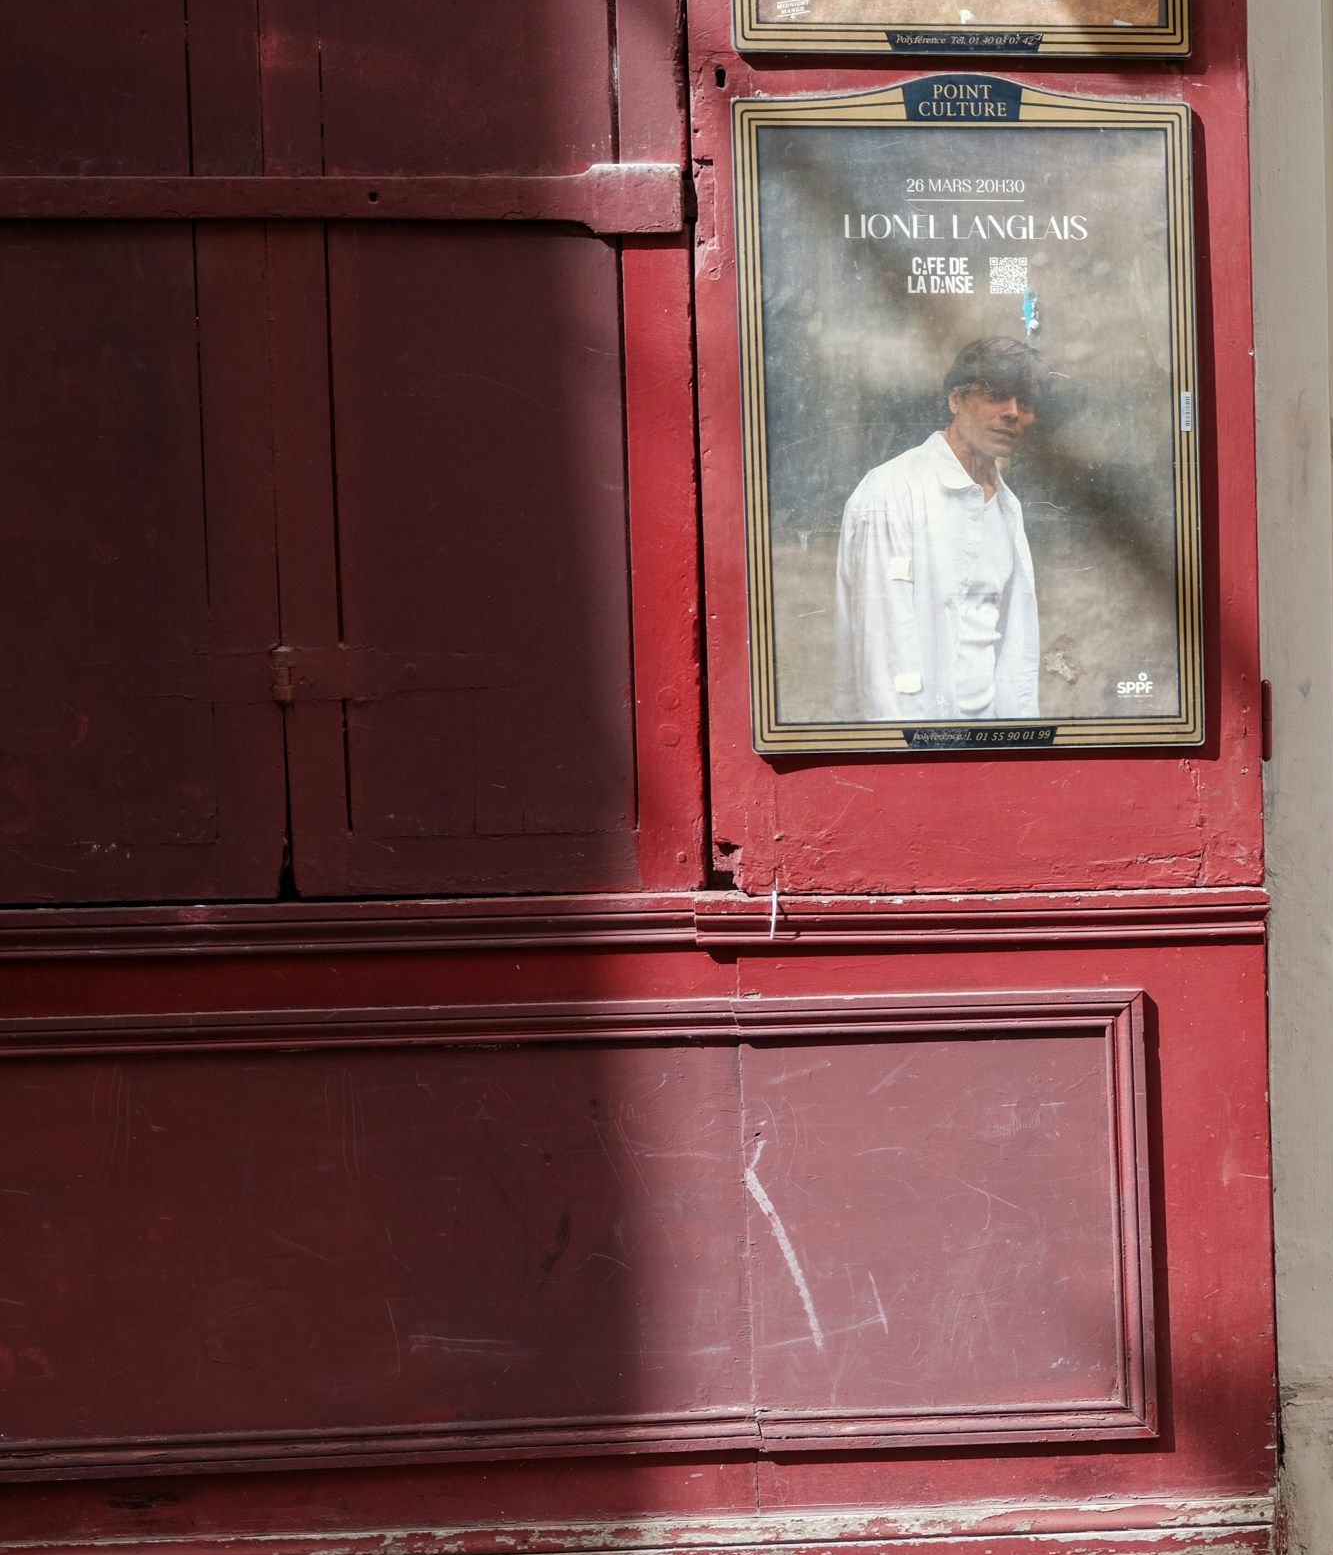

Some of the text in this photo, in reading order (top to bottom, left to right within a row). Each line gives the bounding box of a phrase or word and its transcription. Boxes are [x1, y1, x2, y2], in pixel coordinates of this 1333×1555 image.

[968, 36, 979, 44] 01
[982, 36, 994, 45] 40
[933, 84, 993, 99] POINT
[918, 101, 1007, 117] CULTURE
[906, 178, 1025, 193] 26 MARS 20H30
[843, 213, 1088, 241] LIONEL LANGLAIS
[911, 256, 969, 275] CAFE DE
[907, 275, 974, 294] LA DANSE
[1117, 681, 1154, 694] SPPF
[976, 732, 988, 741] 01
[991, 731, 1004, 741] 55
[1007, 731, 1020, 741] 90
[1022, 730, 1034, 740] 01
[1037, 729, 1051, 740] 99
